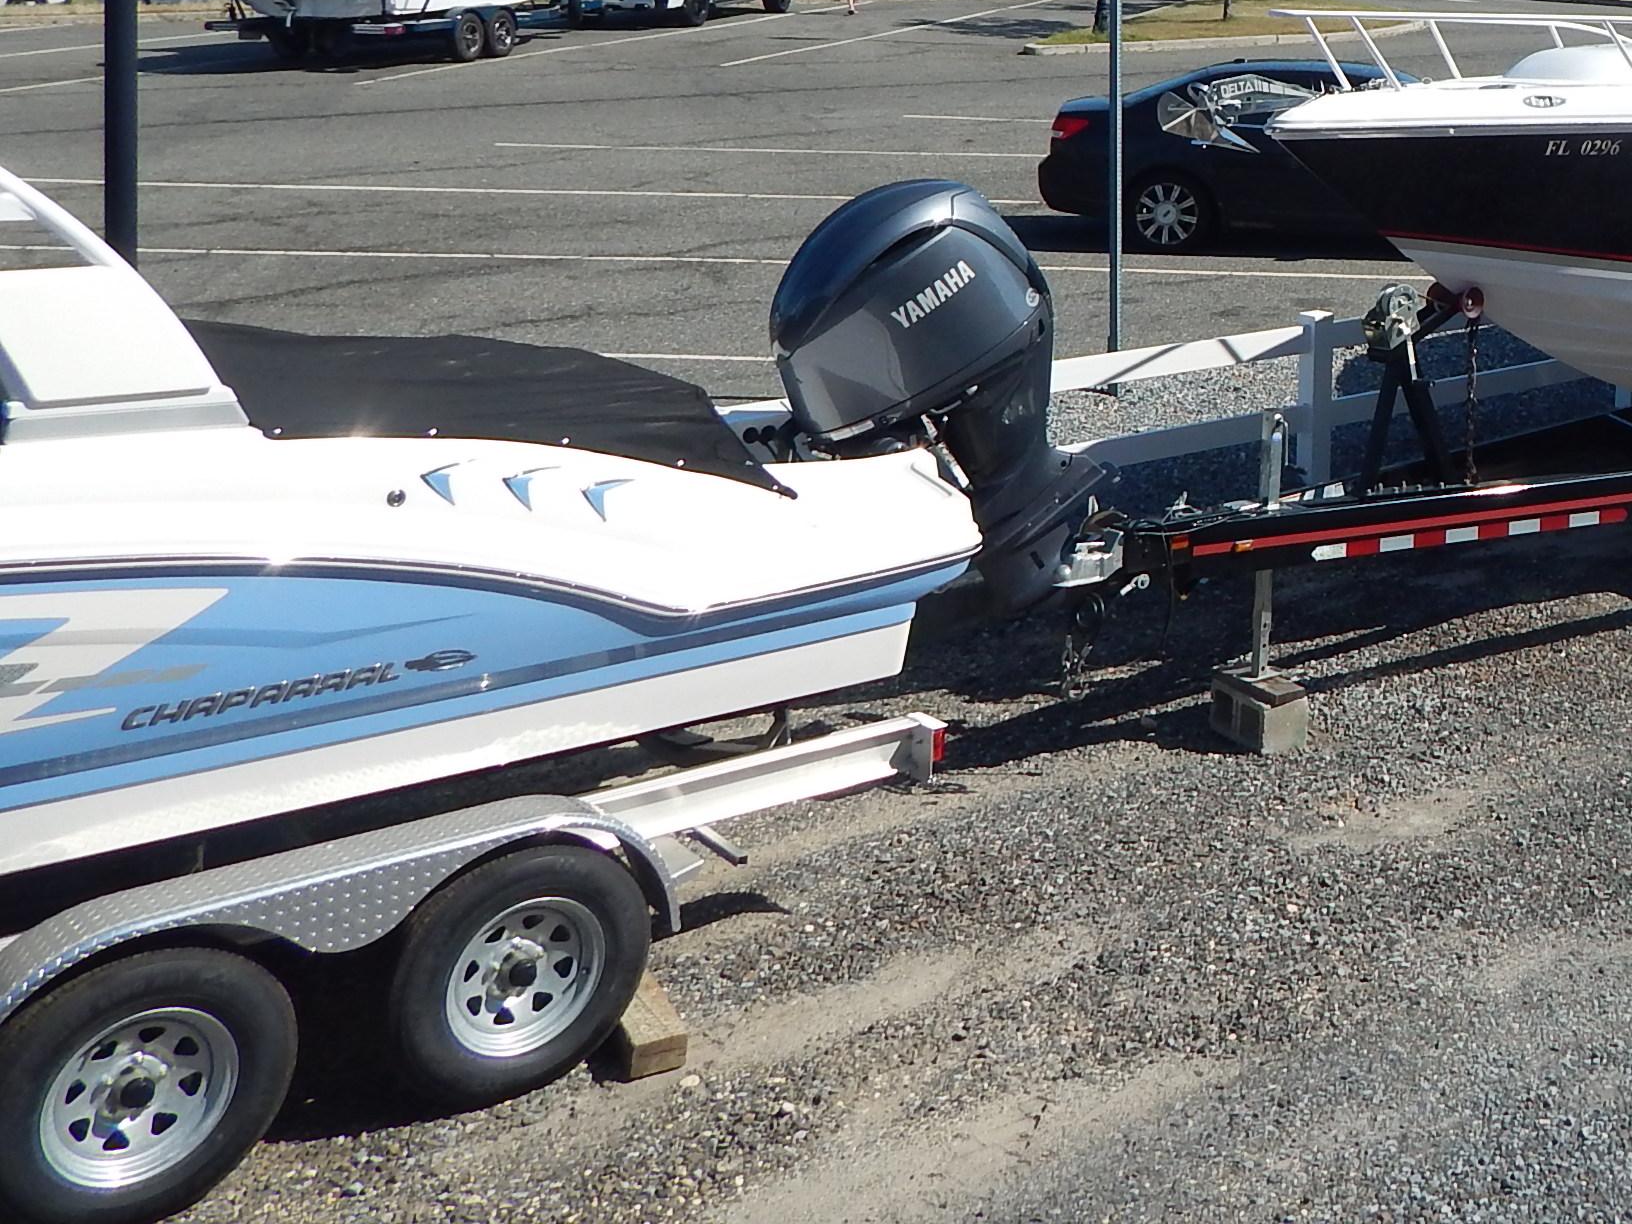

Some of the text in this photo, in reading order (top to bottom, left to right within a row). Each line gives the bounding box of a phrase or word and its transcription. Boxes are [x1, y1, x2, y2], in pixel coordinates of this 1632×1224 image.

[1220, 79, 1254, 99] DELTA
[1545, 139, 1571, 156] FL
[1580, 139, 1622, 156] 0296
[890, 260, 976, 329] YAMAHA
[120, 662, 400, 731] CHAPARRAL
